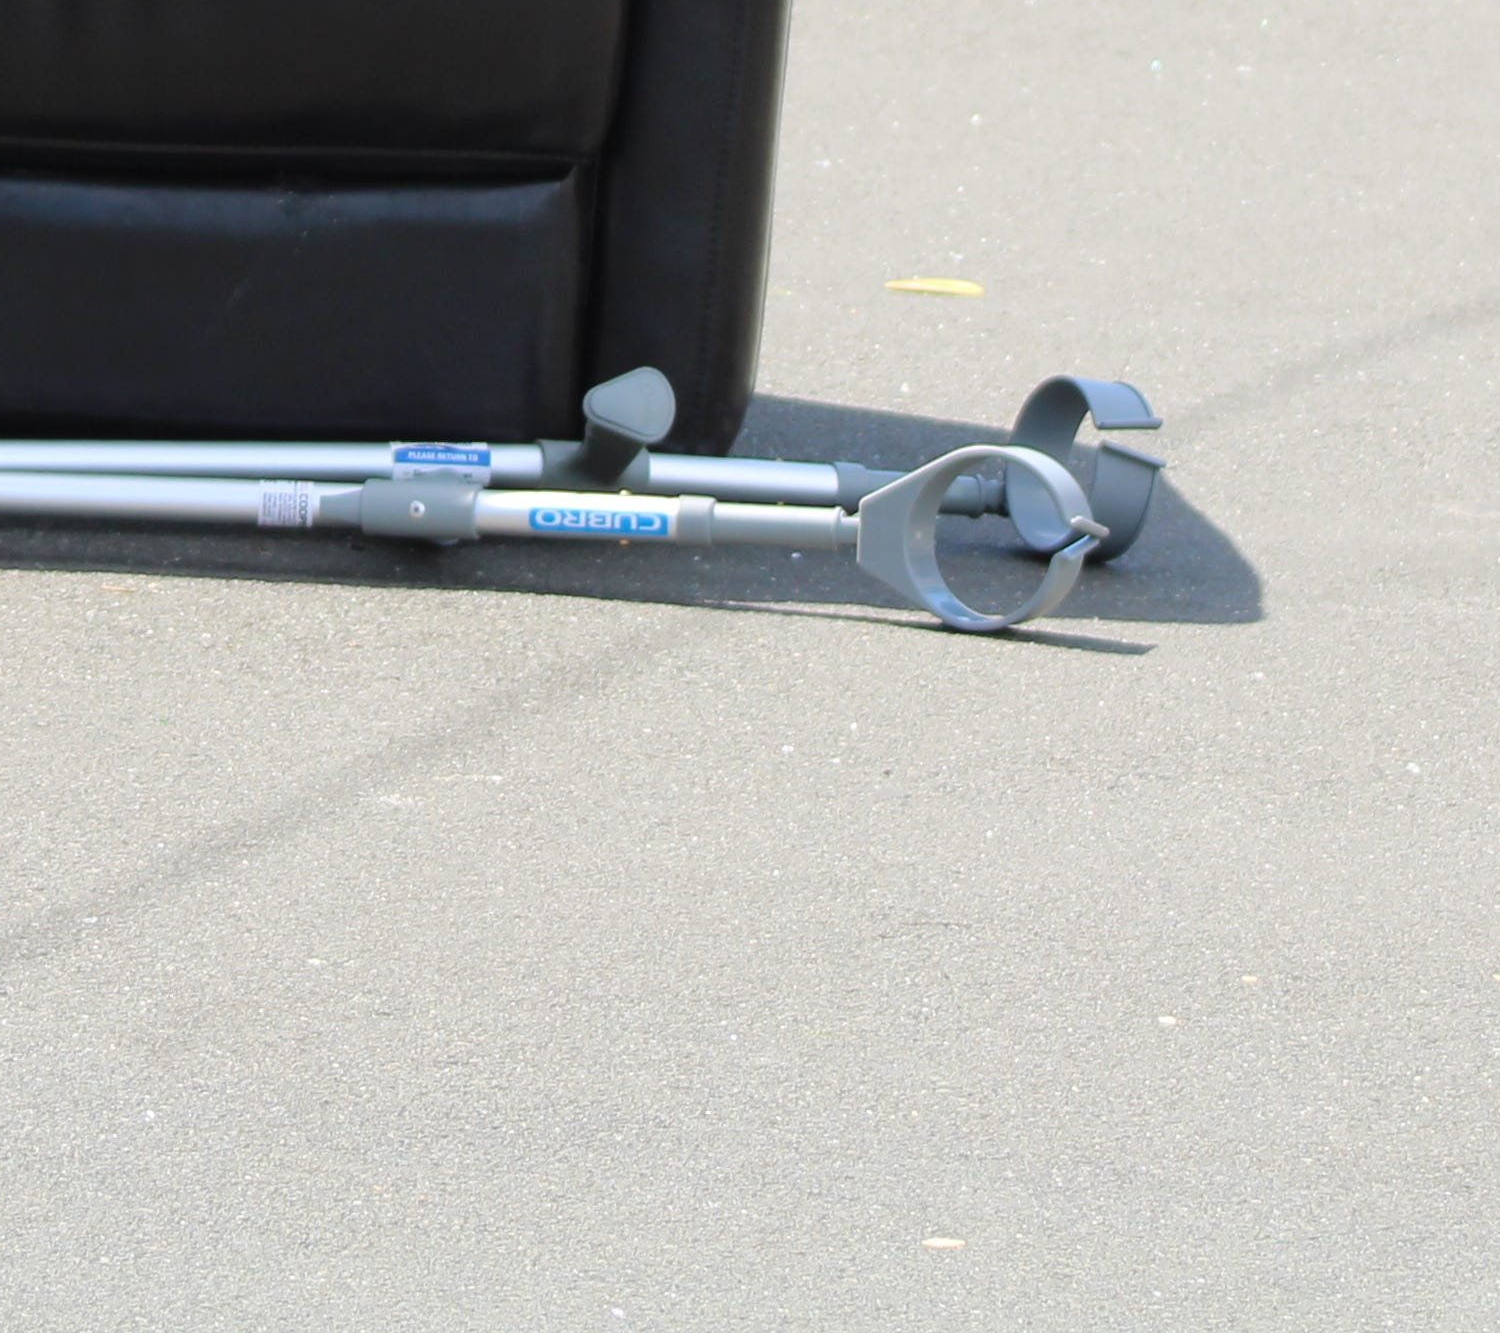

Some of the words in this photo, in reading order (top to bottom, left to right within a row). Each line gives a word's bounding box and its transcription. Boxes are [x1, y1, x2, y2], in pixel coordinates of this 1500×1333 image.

[407, 450, 436, 461] PLEASE
[437, 451, 467, 462] RETURN
[468, 453, 479, 463] TO
[535, 508, 662, 531] CUBRO
